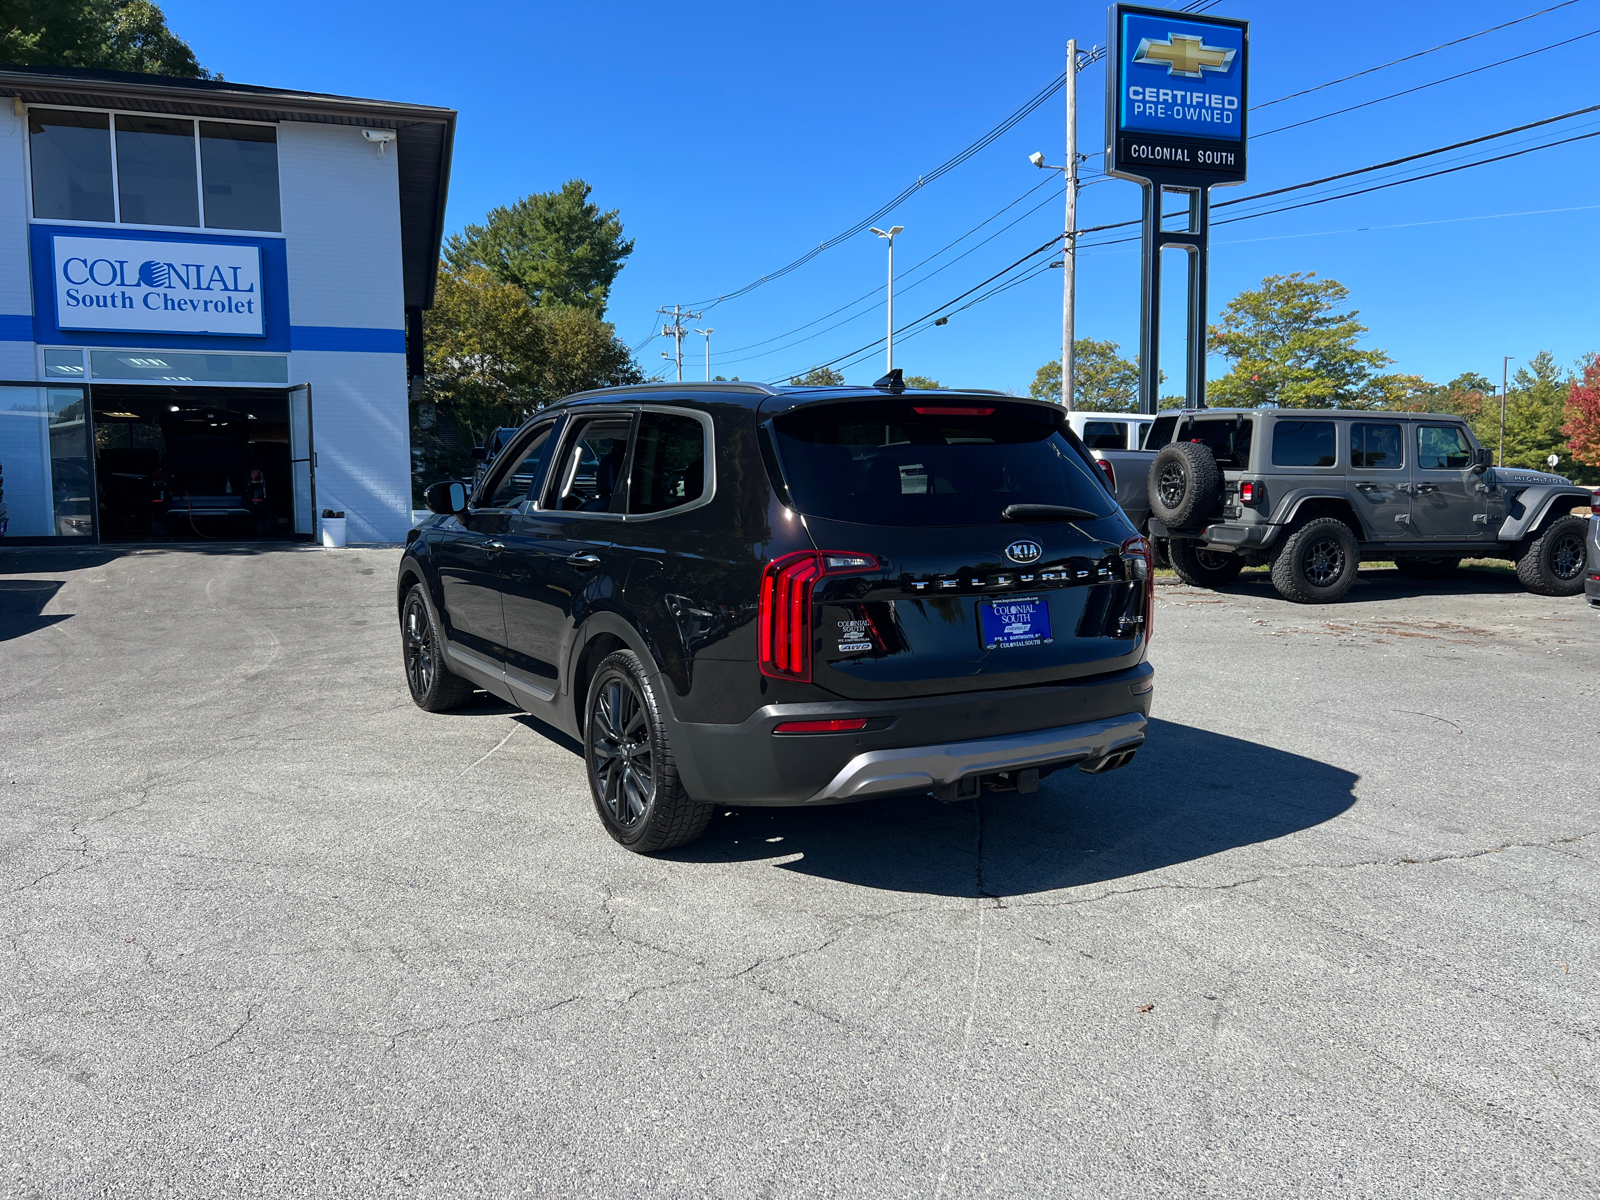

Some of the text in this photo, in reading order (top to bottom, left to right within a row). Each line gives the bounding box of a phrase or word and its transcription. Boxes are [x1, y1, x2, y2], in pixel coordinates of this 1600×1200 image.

[1129, 85, 1238, 110] CERTIFIED
[1134, 102, 1233, 124] PRE-OWNED
[1131, 144, 1235, 165] COLONIAL SOUTH
[62, 257, 254, 293] COLONIAL
[66, 288, 254, 314] South Chevrolet
[1011, 543, 1038, 559] KIA
[911, 567, 1108, 590] TELLURIDE
[994, 604, 1036, 616] COLONIAL
[1001, 613, 1031, 624] SOUTH
[842, 625, 866, 633] SOUTH
